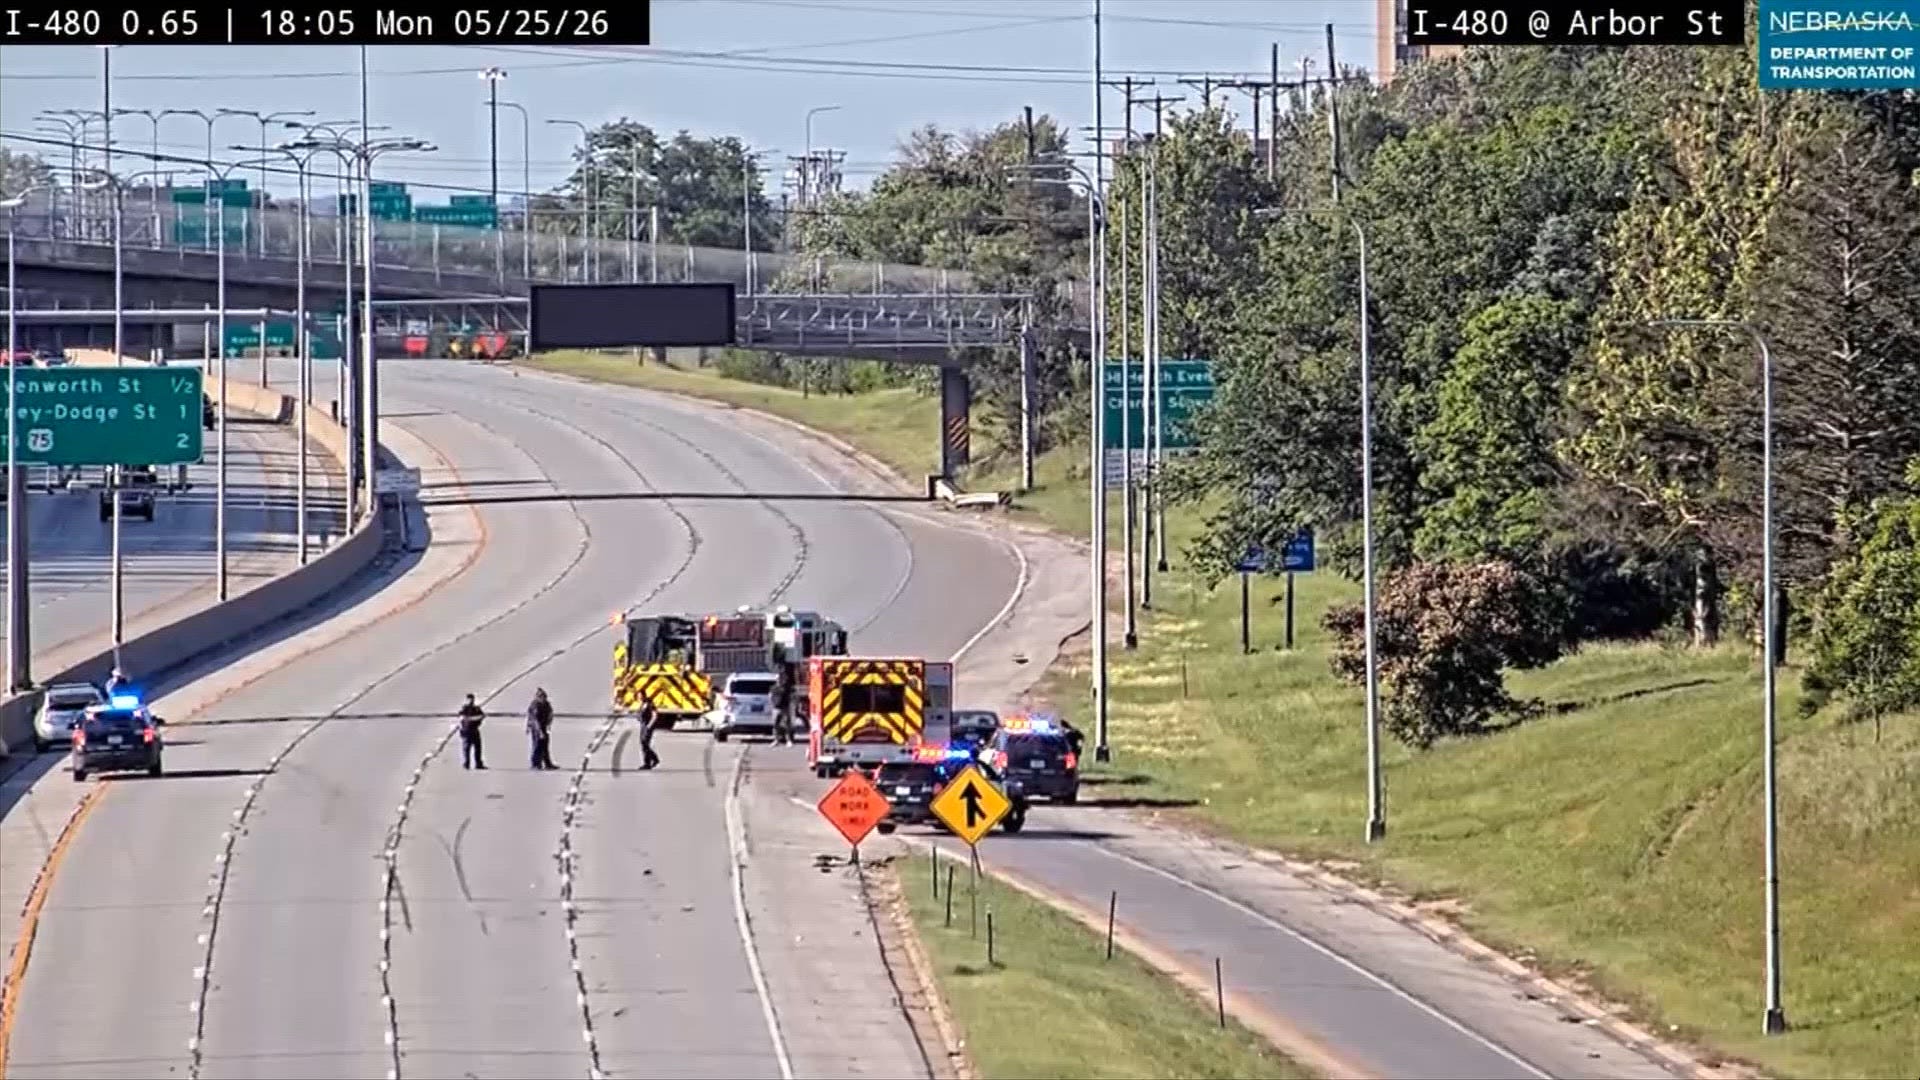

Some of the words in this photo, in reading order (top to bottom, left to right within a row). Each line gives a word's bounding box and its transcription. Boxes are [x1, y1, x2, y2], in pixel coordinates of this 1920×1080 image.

[118, 377, 141, 393] St
[133, 404, 156, 420] St
[180, 404, 187, 419] 1
[31, 433, 49, 447] 75
[176, 433, 190, 448] 2
